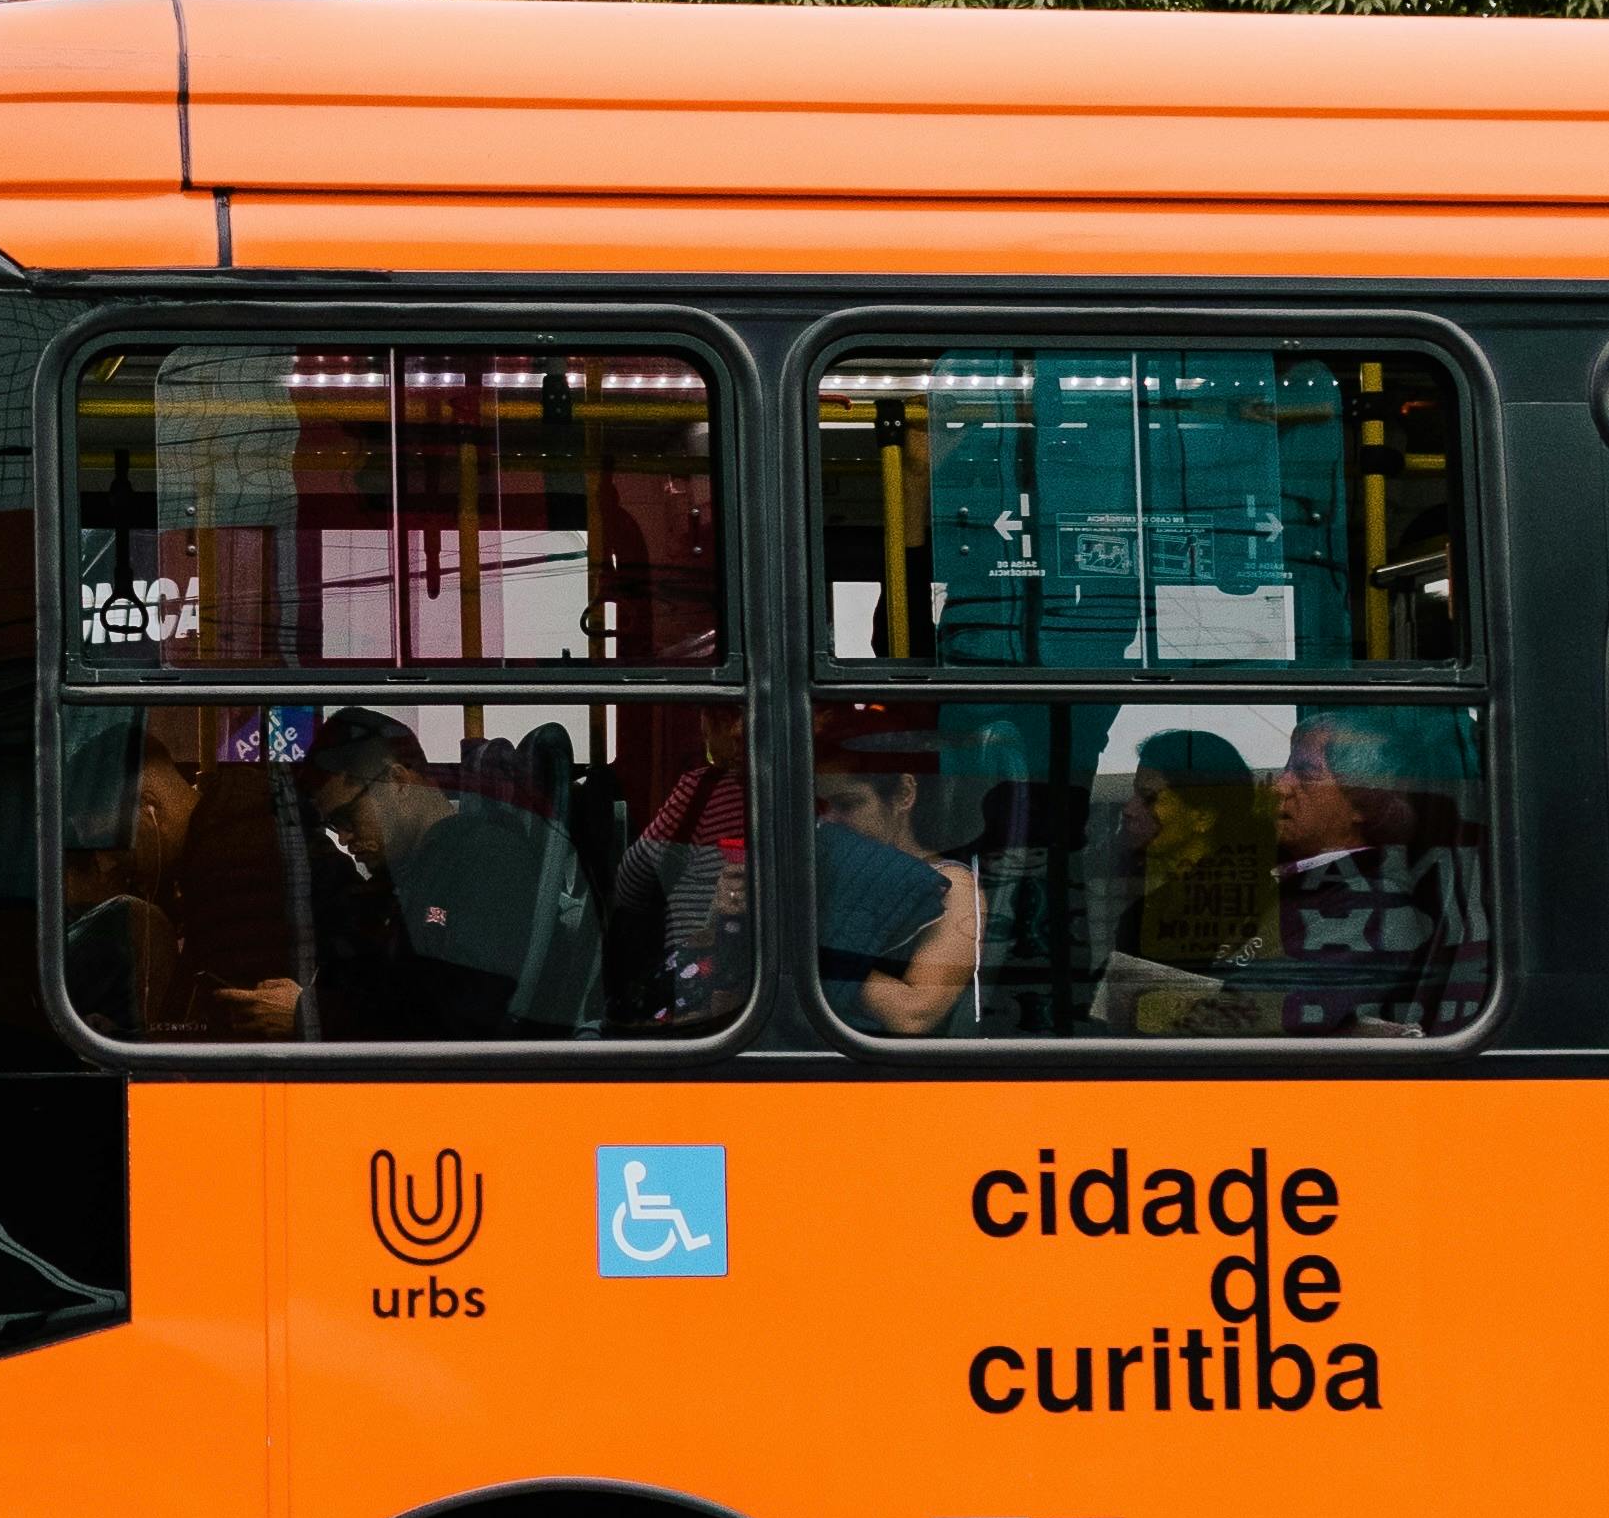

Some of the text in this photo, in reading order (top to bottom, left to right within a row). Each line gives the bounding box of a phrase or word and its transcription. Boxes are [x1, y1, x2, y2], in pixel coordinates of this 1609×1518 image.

[972, 1147, 1340, 1238] cidade
[372, 1276, 486, 1320] urbs
[1210, 1246, 1342, 1324] de
[967, 1326, 1383, 1415] curitiba
